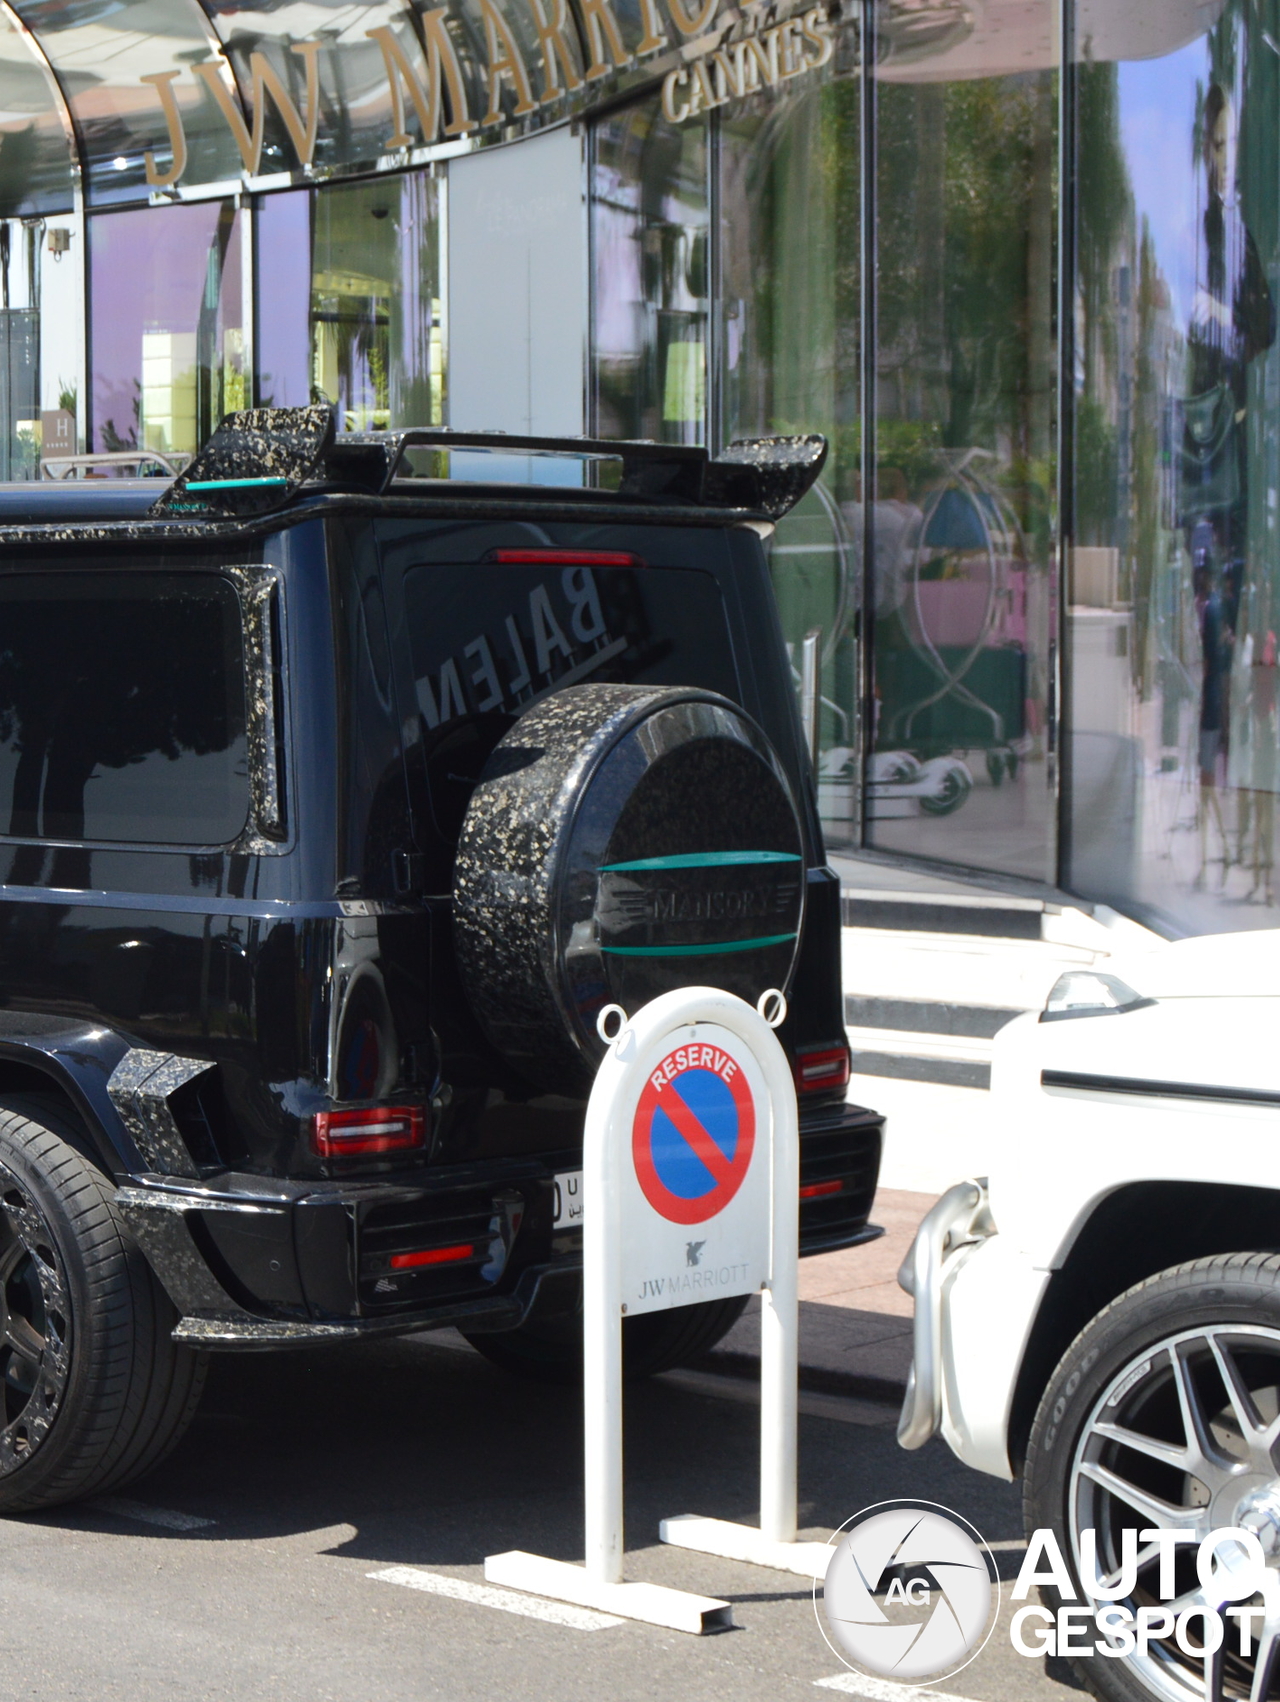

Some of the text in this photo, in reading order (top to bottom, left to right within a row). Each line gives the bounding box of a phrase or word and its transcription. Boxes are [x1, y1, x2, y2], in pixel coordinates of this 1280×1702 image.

[661, 7, 833, 124] CANNES
[140, 40, 322, 187] JW
[56, 418, 68, 437] H
[651, 1045, 738, 1093] RESERVE
[668, 1263, 749, 1294] MARRIOTT
